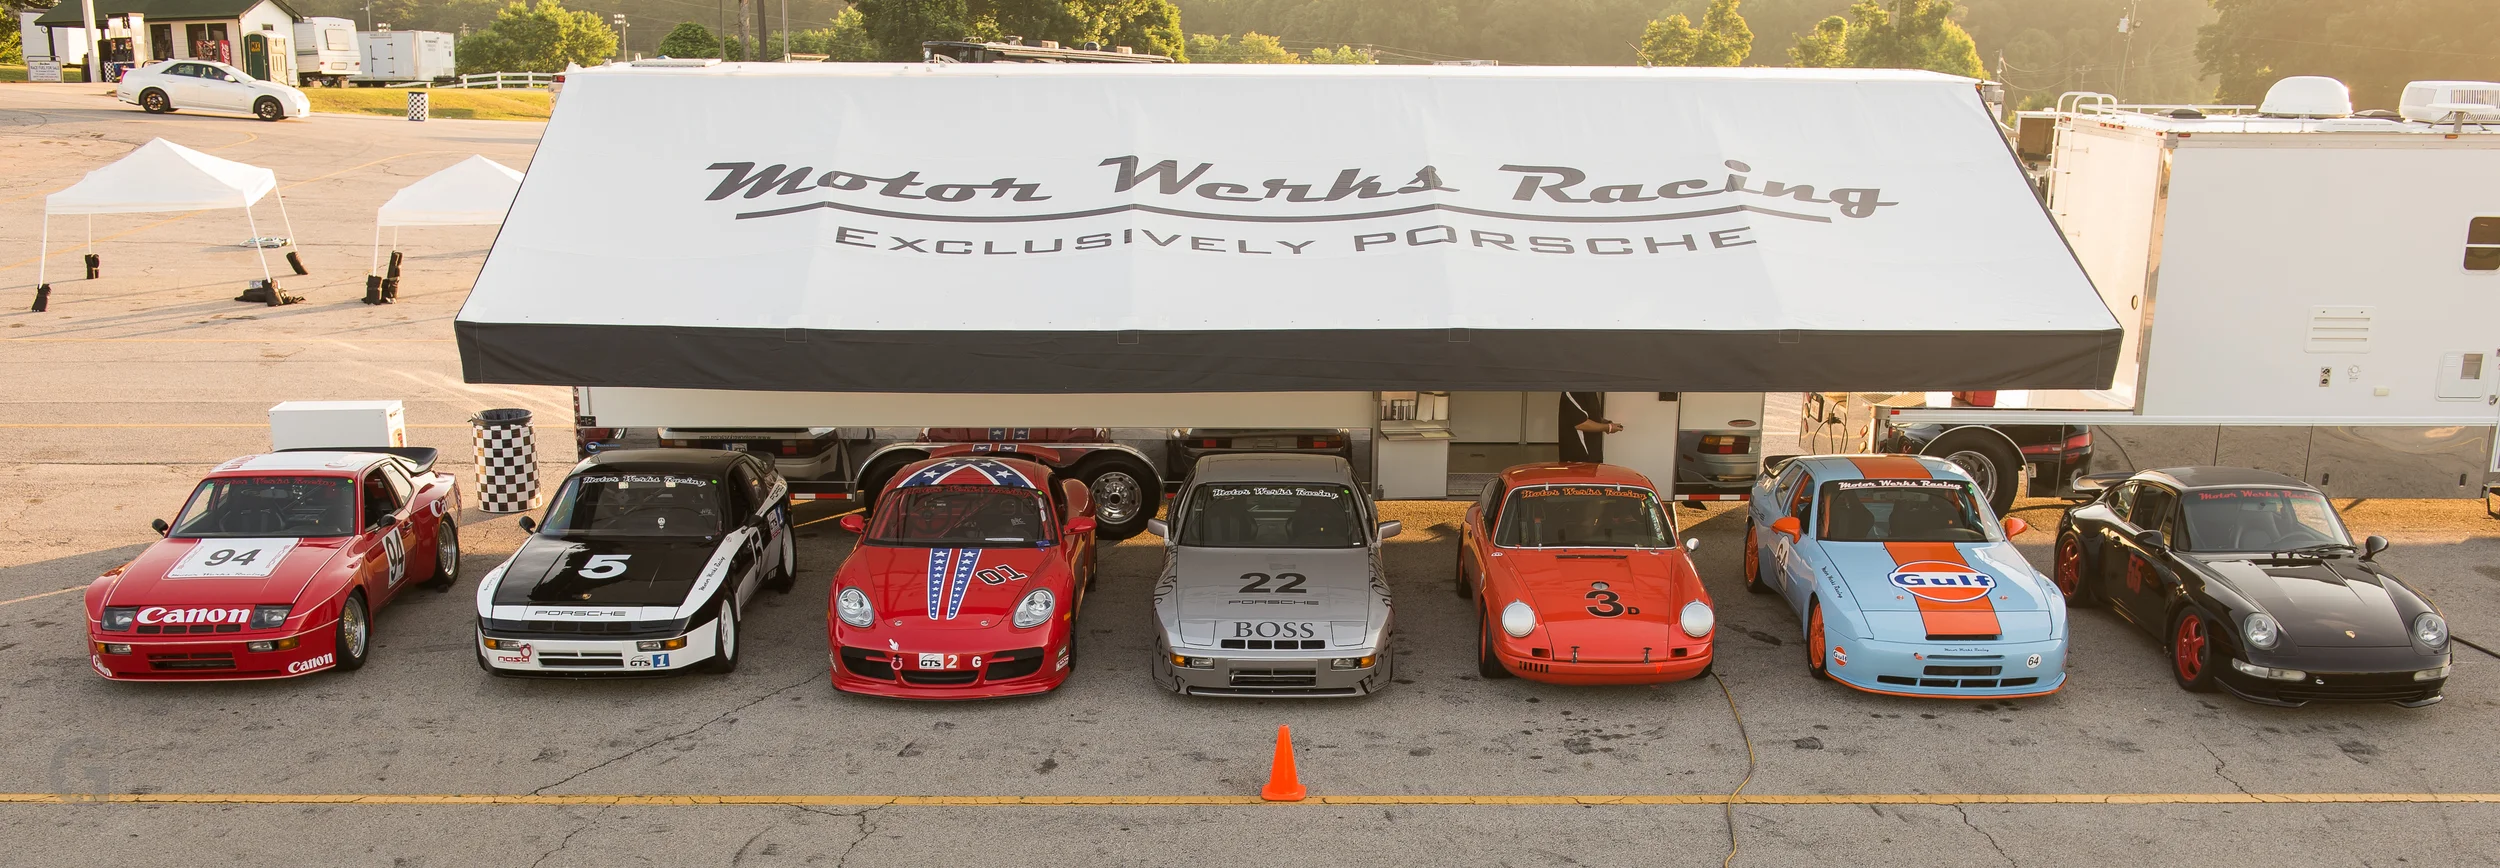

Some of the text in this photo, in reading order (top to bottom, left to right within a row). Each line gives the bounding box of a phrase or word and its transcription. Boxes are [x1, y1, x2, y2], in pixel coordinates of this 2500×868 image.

[705, 155, 1899, 219] Motor Werks Racing
[836, 225, 1757, 255] EXCLUSIVELY PORSCHE
[213, 478, 248, 486] Motor
[293, 477, 336, 487] Racing
[583, 475, 707, 487] Motor Werks Racing
[1838, 480, 1962, 491] Motor Werks Racing
[904, 487, 942, 495] Motor
[988, 486, 1031, 497] Racing
[1213, 488, 1339, 499] Motor Werks Racing
[1521, 487, 1647, 500] Motor Werks Racing
[2200, 490, 2321, 503] Motor Werks Racing
[204, 549, 262, 566] 94
[386, 529, 405, 580] 94
[578, 554, 632, 579] 5
[975, 563, 1028, 586] 01
[1895, 573, 1994, 587] Gulf
[1238, 572, 1307, 594] 22
[1584, 589, 1641, 618] 3 D
[137, 607, 250, 624] Canon
[1233, 621, 1315, 639] BOSS
[288, 652, 334, 674] Canon
[630, 654, 667, 667] GTS 1
[920, 655, 982, 669] GTS 2 G
[1833, 650, 1848, 662] Gulf
[2028, 656, 2040, 666] 64
